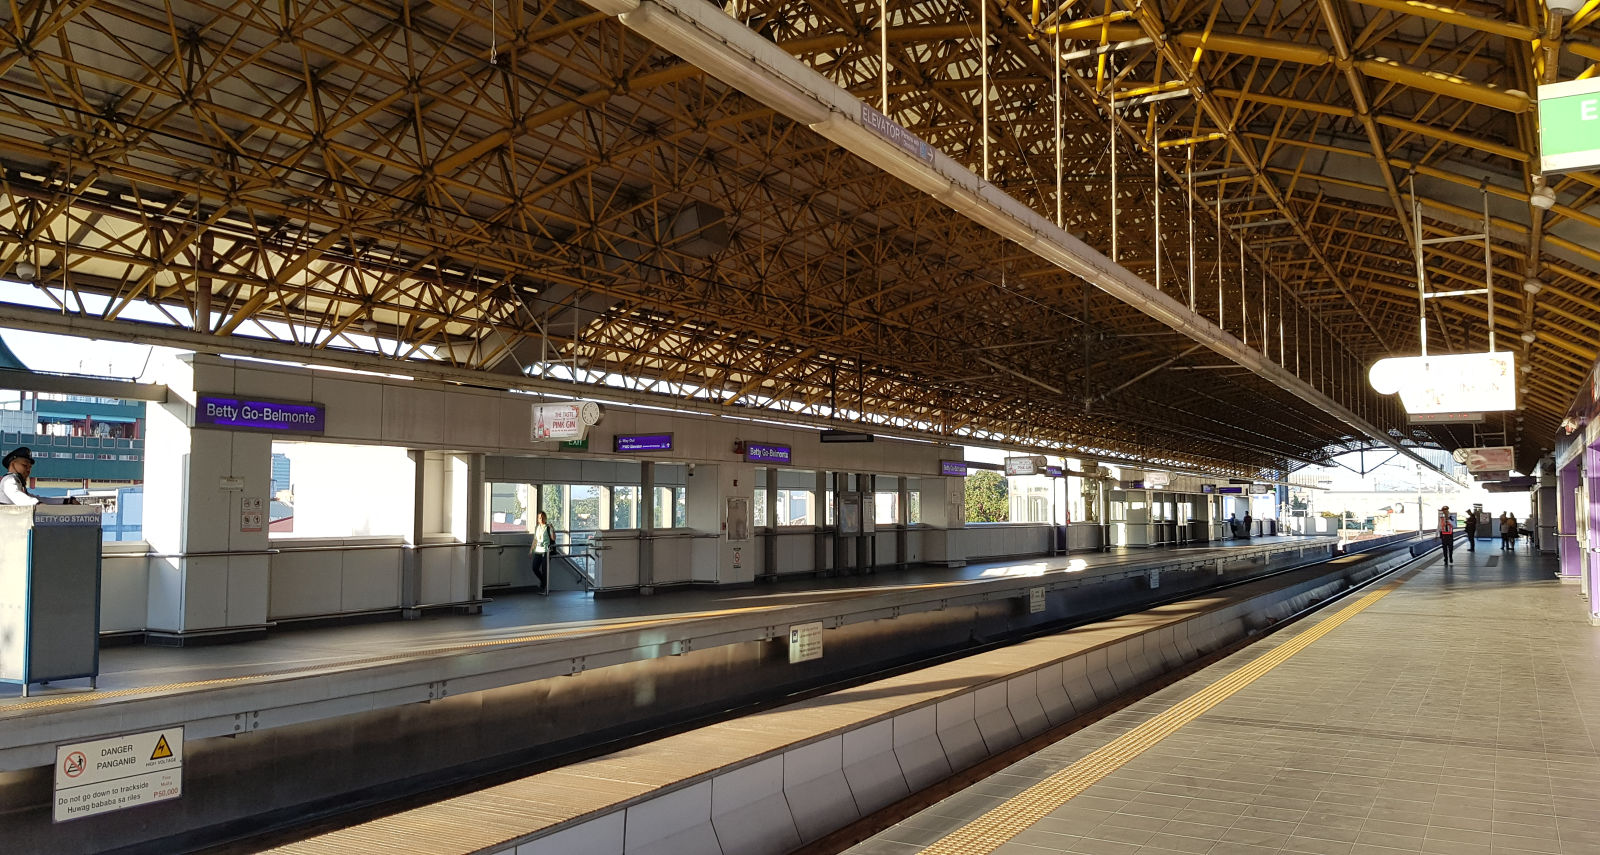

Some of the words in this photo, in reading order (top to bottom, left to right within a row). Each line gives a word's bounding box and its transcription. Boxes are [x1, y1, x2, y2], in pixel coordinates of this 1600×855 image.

[863, 107, 900, 139] ELEVATOR
[207, 403, 239, 421] Betty
[242, 406, 316, 424] Go-Belmonte
[750, 447, 761, 458] Betty
[35, 515, 58, 523] BETTY
[59, 515, 70, 523] GO
[71, 515, 100, 523] STATION
[101, 744, 133, 757] DANGER
[96, 756, 136, 770] PANGANIB
[157, 757, 177, 765] VOLTAGE
[58, 797, 68, 805] Do
[69, 795, 81, 803] not
[82, 794, 91, 803] go
[92, 788, 111, 798] down
[120, 781, 149, 793] trackside
[67, 803, 90, 814] Huwag
[91, 798, 117, 809] bababa
[127, 793, 141, 802] riles
